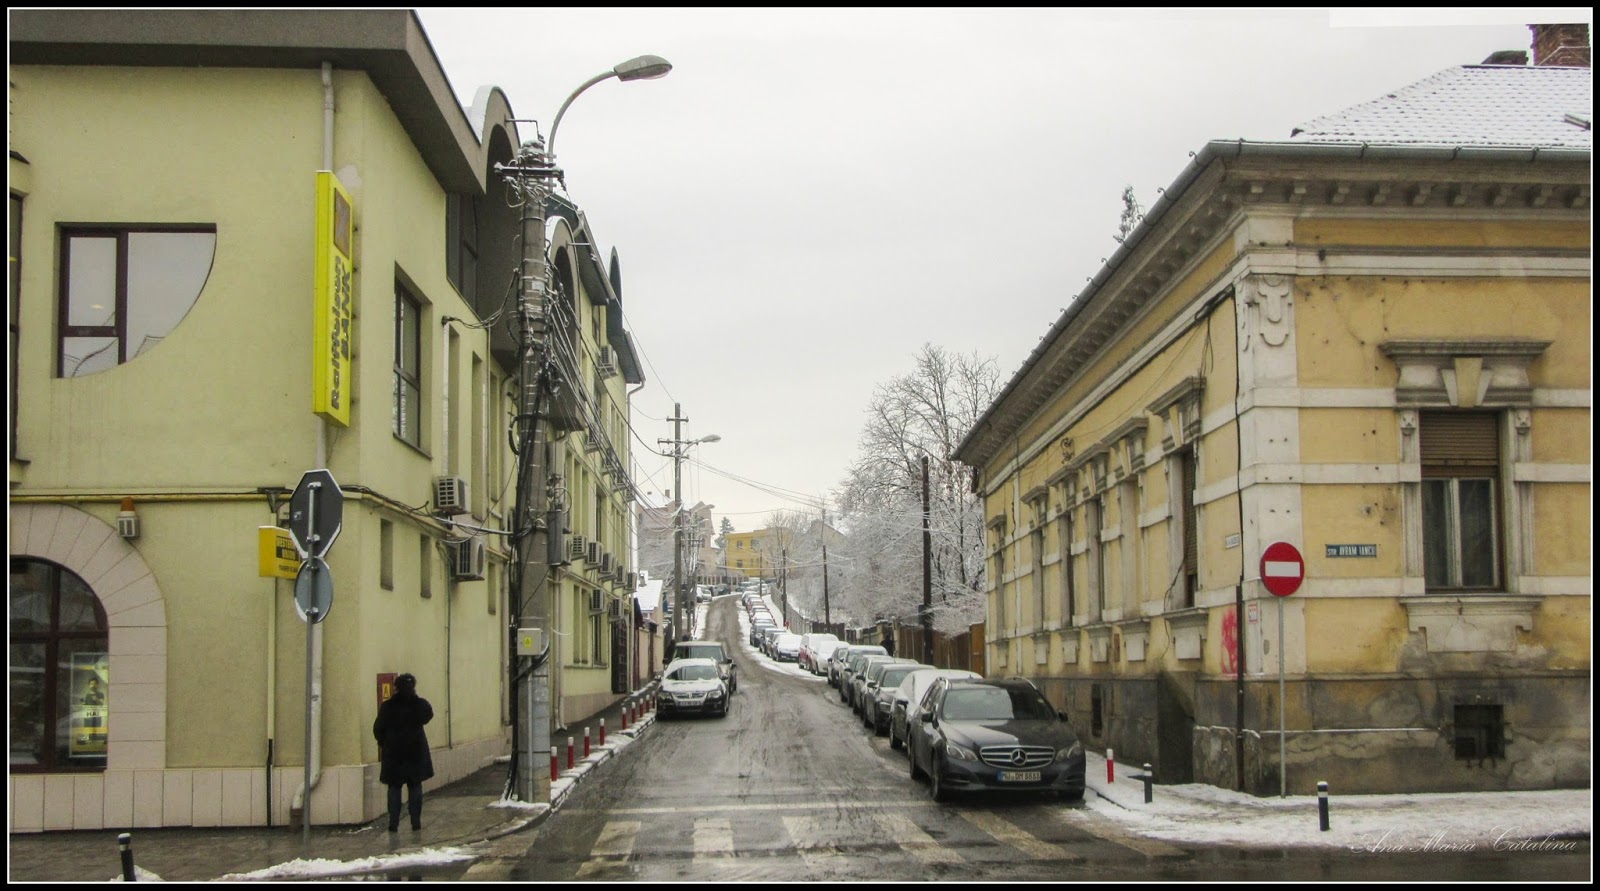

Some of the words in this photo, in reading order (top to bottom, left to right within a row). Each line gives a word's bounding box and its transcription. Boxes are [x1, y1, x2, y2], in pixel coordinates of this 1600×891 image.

[332, 255, 341, 410] Raiffeisen
[341, 262, 350, 361] BANK
[1339, 545, 1357, 556] AVRAM
[1359, 545, 1376, 556] IANCU
